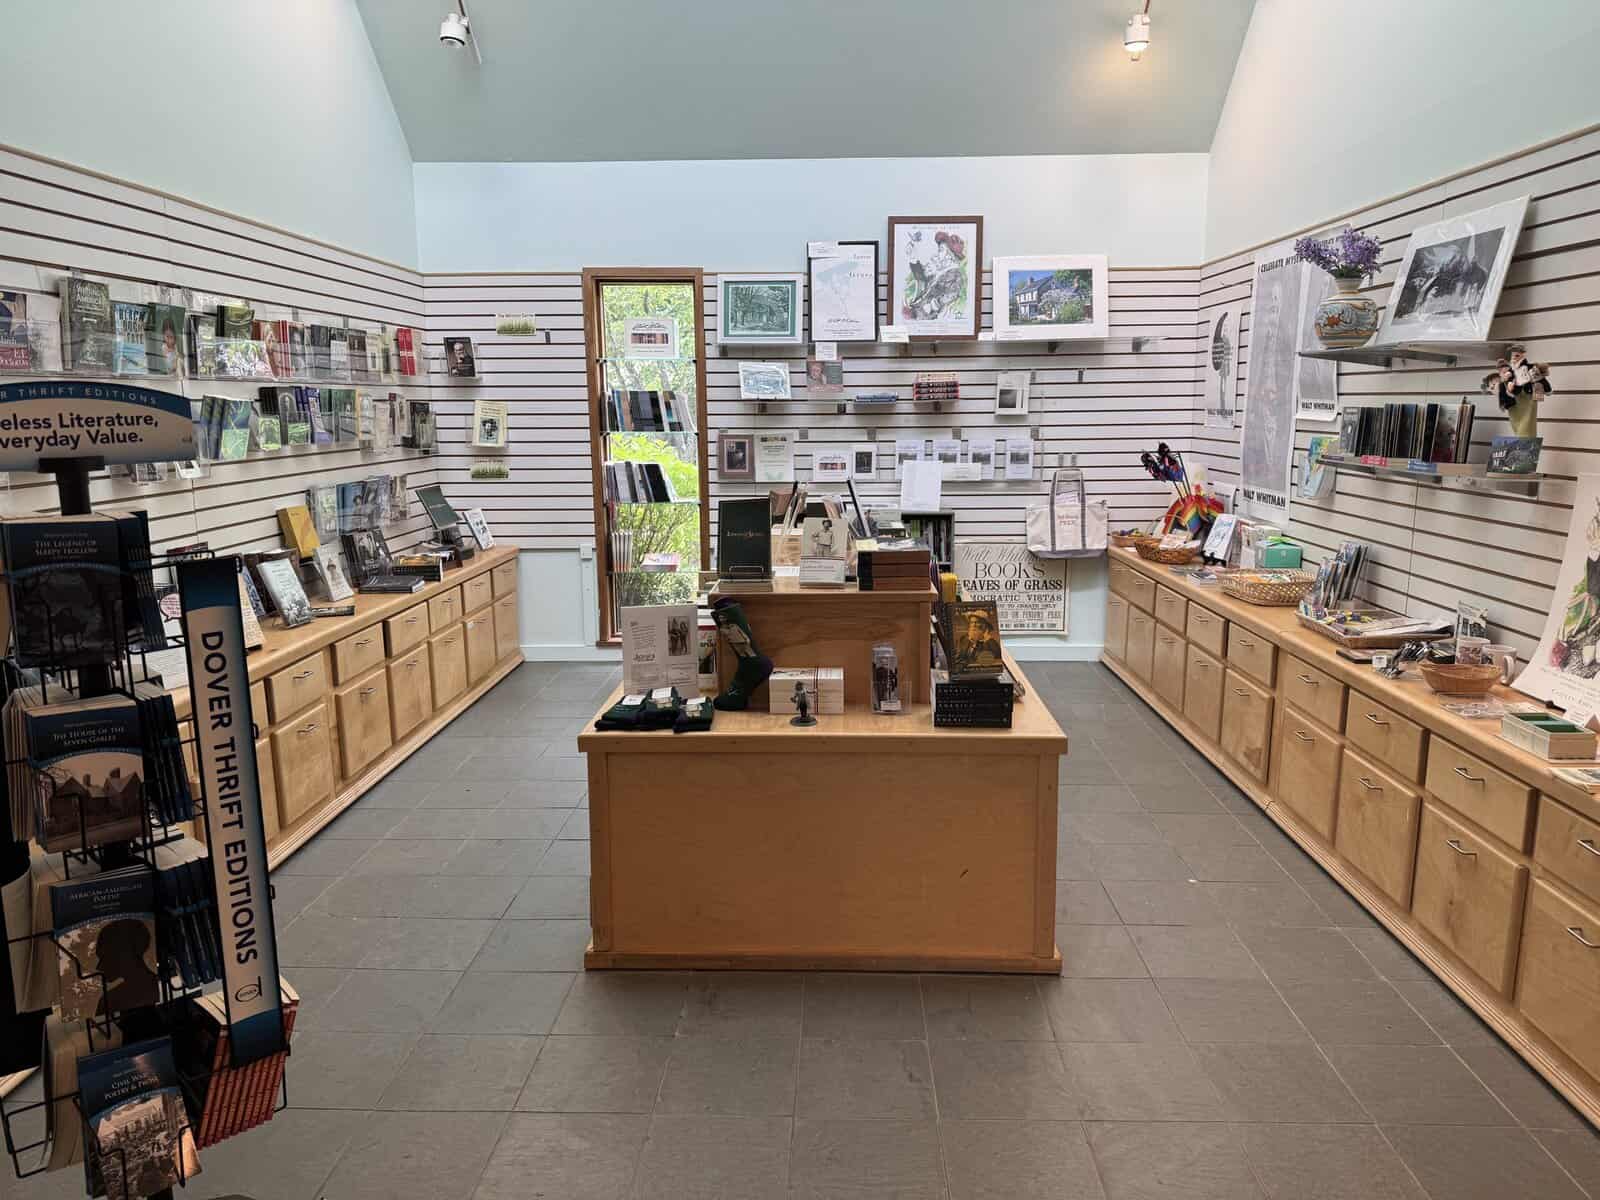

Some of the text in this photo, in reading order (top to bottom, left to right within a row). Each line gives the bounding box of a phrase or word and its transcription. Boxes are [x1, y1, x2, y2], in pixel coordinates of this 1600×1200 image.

[1260, 258, 1284, 273] CELEBRATE
[18, 387, 74, 398] THRIFT
[84, 387, 157, 405] EDITIONS
[1301, 401, 1335, 411] WALT WHITMAN
[0, 412, 159, 430] eless Literature,
[0, 428, 144, 452] veryday Value.
[1243, 487, 1286, 508] WALT WHITMAN
[975, 561, 1046, 579] BOOKS
[962, 580, 1063, 592] EAVES OF GRASS
[1027, 594, 1063, 602] VISTAS
[200, 631, 258, 965] DOVER THRIFT EDITIONS
